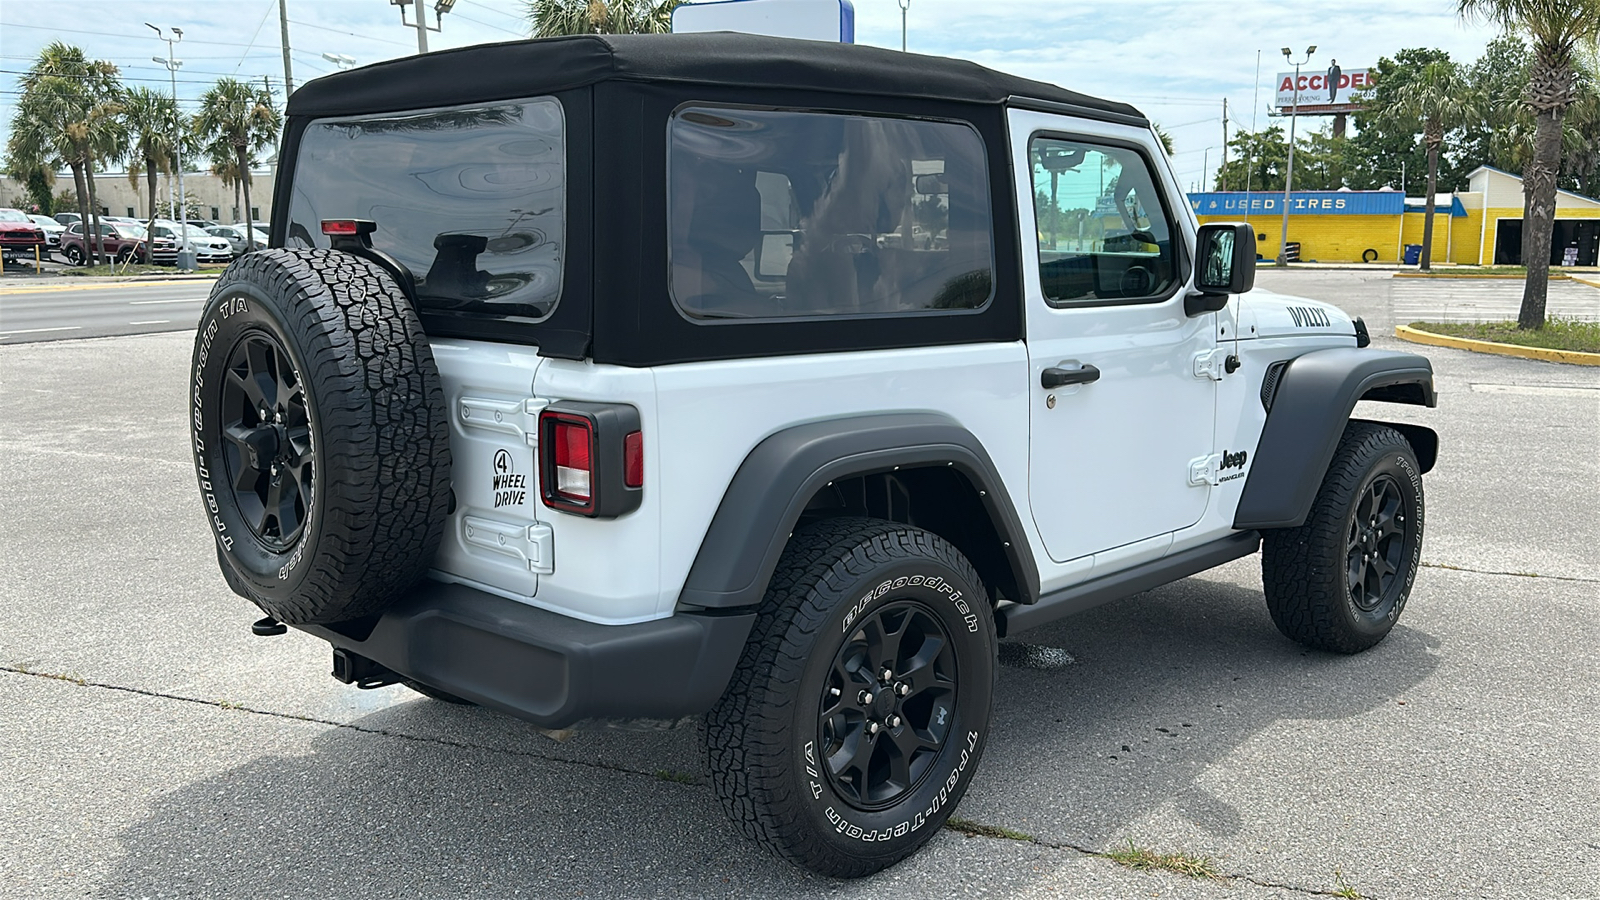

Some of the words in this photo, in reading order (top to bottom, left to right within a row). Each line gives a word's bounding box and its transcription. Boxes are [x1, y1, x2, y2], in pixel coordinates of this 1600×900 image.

[1225, 199, 1275, 210] USED
[1286, 306, 1331, 327] WILLYS
[497, 454, 507, 472] 4
[1219, 449, 1248, 470] Jeep
[493, 475, 526, 491] WHEEL
[1218, 472, 1245, 483] WRANGLER
[495, 490, 526, 508] DRIVE
[841, 573, 979, 633] BFGoodrich
